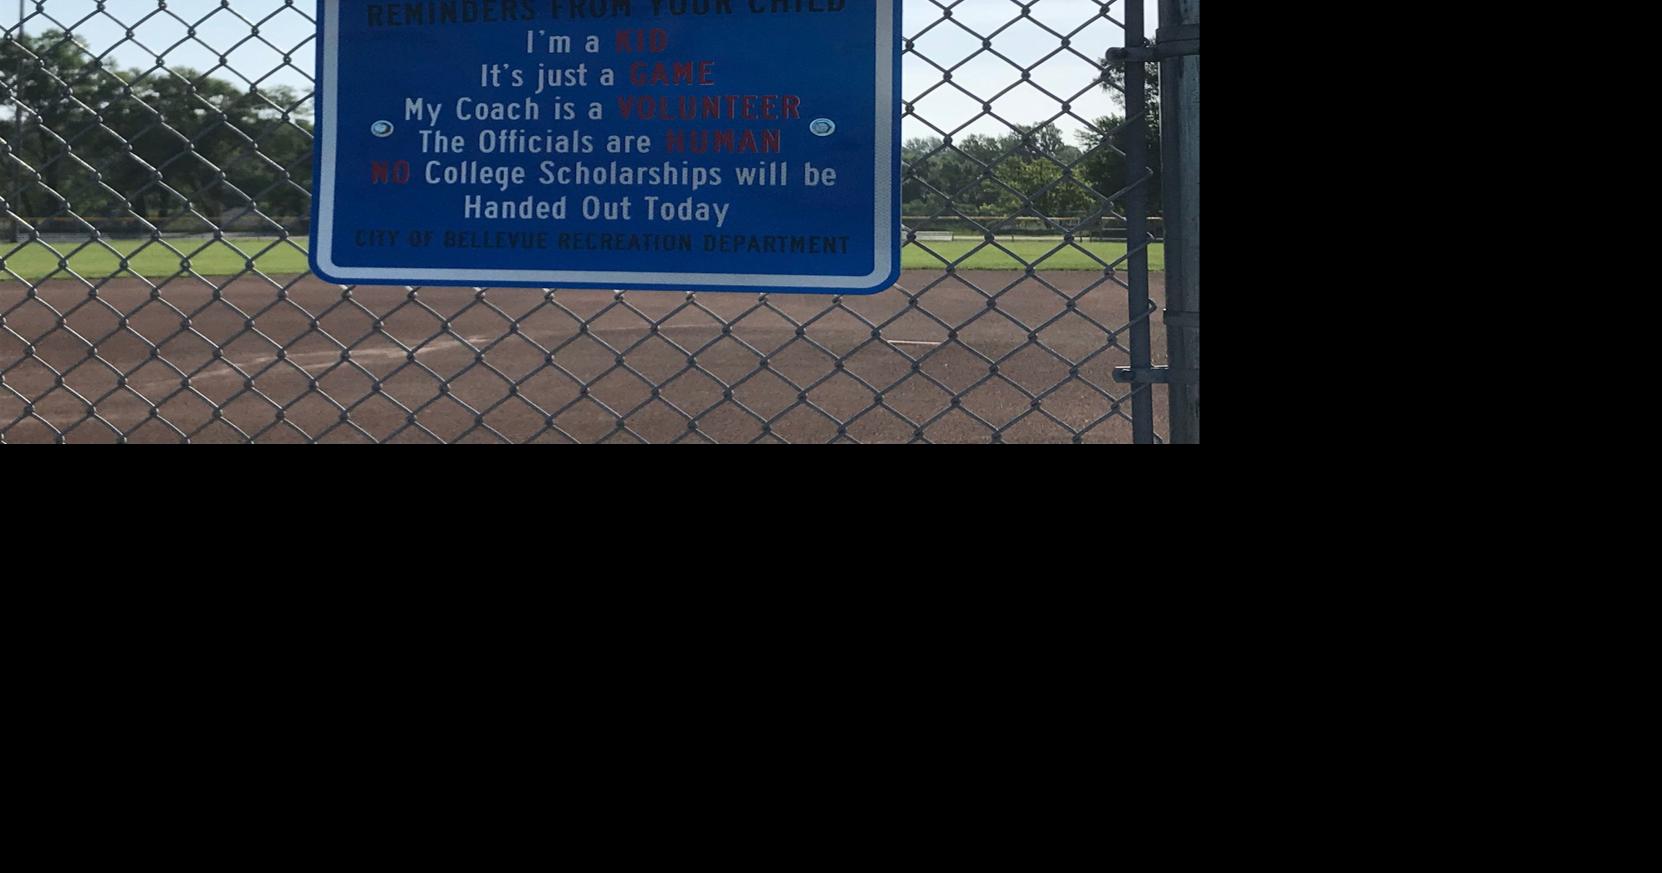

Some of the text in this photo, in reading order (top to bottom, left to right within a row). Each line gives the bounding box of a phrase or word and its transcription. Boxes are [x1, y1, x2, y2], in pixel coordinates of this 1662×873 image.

[367, 0, 536, 27] REMINDERS
[551, 0, 631, 19] FROM
[527, 28, 668, 54] I'm a KID
[481, 61, 715, 94] It's just a GAME
[405, 95, 801, 126] My Coach is a VOLUNTEER
[419, 128, 781, 154] The Officials are HUMAN
[371, 160, 837, 191] NO College Scholarships will be
[464, 195, 729, 228] Handed Out Today
[355, 230, 850, 256] CITY OF BELLEVUE RECREATION DEPARTMENT
